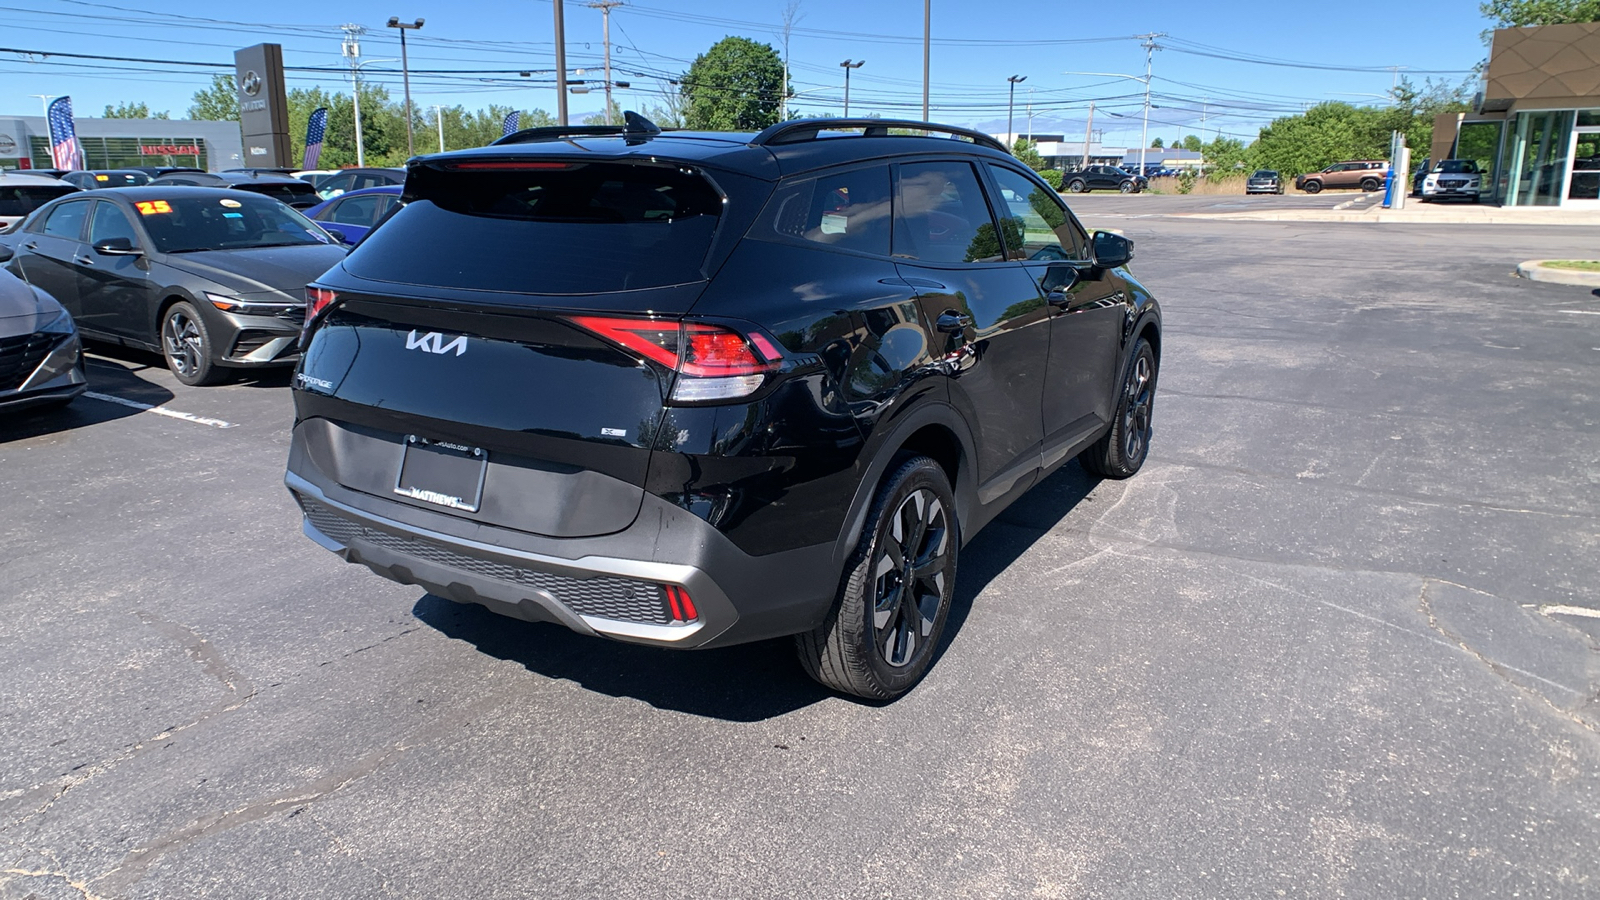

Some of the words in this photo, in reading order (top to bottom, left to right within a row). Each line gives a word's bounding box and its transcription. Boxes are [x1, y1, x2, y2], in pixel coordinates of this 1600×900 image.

[141, 145, 200, 155] NISSAN
[136, 201, 171, 215] 25
[405, 329, 467, 357] KIA
[297, 373, 332, 389] SPORTAGE
[411, 488, 459, 507] MATTHEWS
